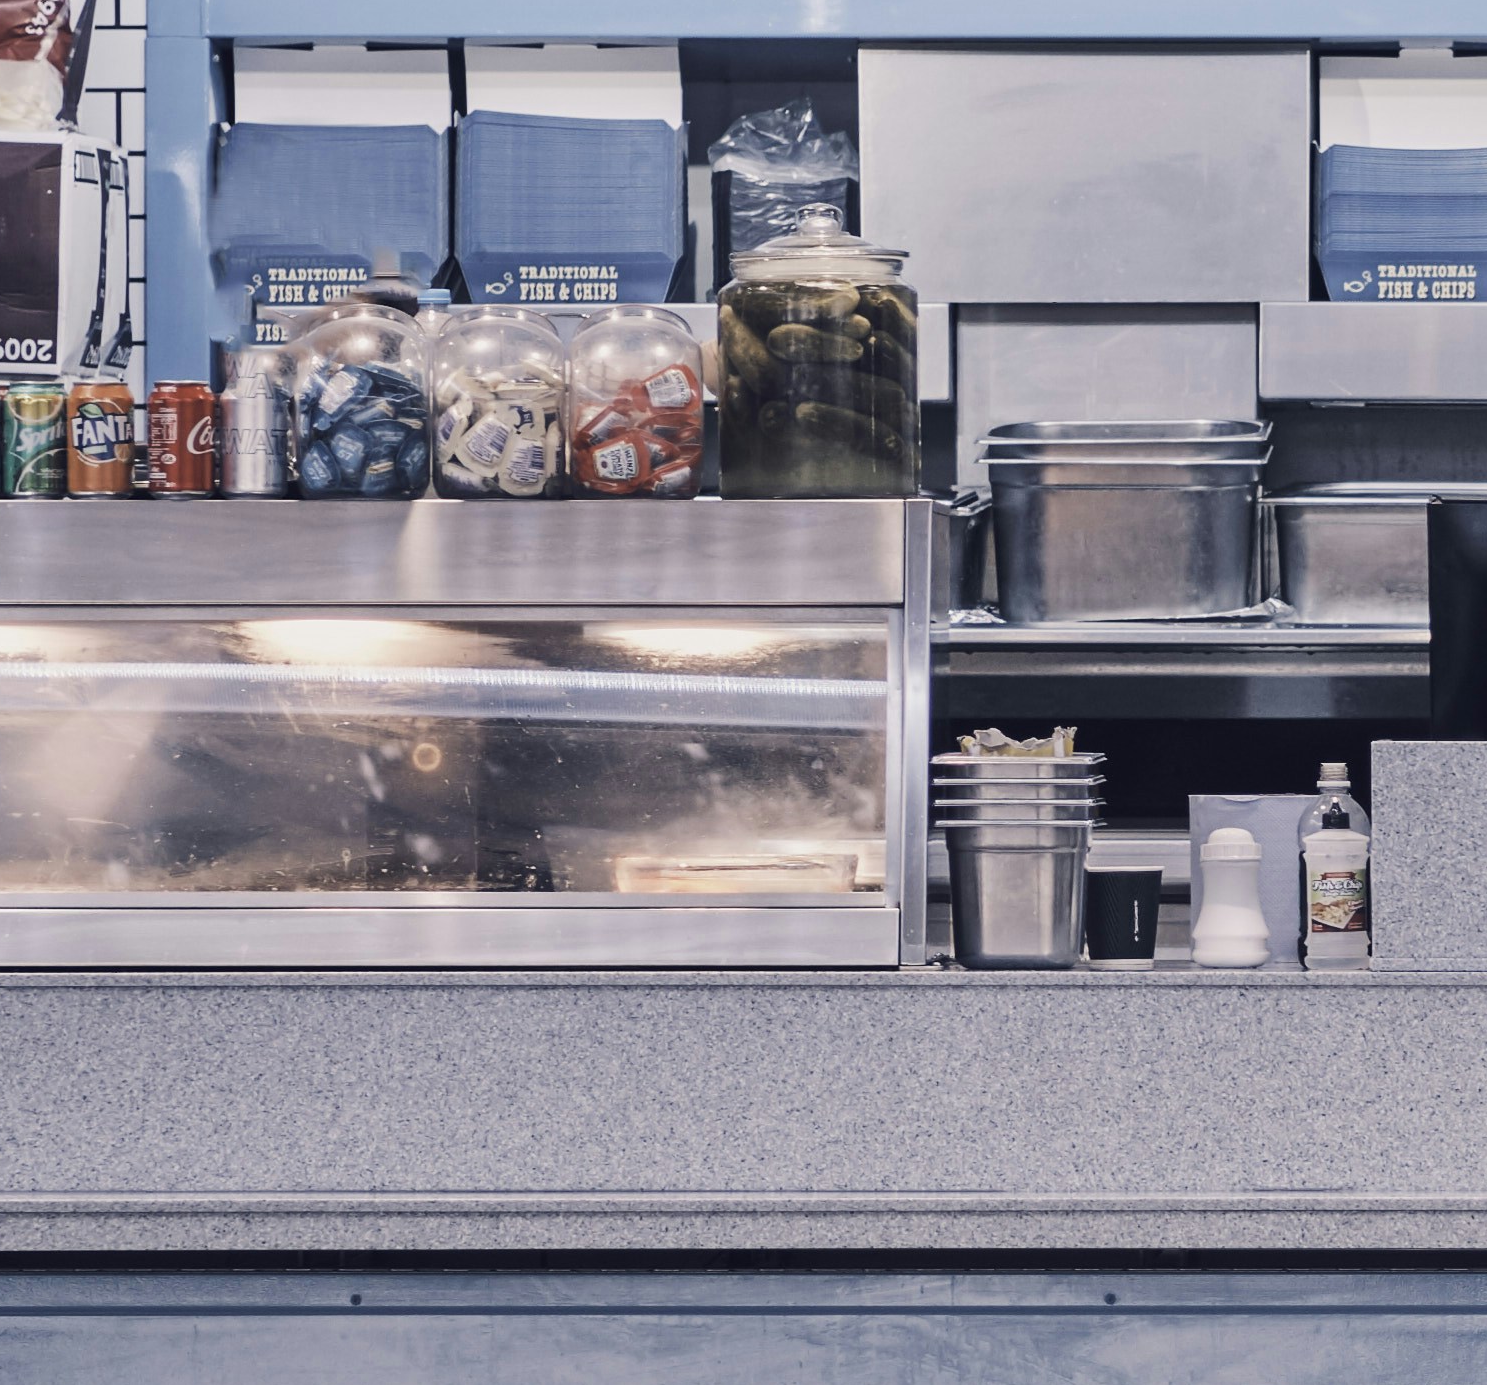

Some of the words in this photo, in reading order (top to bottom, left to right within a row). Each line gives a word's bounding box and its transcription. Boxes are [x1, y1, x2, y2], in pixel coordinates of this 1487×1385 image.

[268, 267, 368, 282] TRADITIONAL
[520, 266, 618, 279] TRADITIONAL
[1378, 265, 1477, 277] TRADITIONAL
[268, 284, 304, 303] FISH
[307, 284, 320, 303] &
[322, 284, 364, 302] CHI
[520, 283, 555, 300] FISH
[559, 283, 569, 300] &
[574, 283, 617, 300] CHIPS
[1378, 281, 1413, 298] FISH
[1417, 281, 1428, 298] &
[1432, 281, 1475, 298] CHIPS
[70, 412, 135, 449] FANTA
[221, 428, 288, 455] WAT
